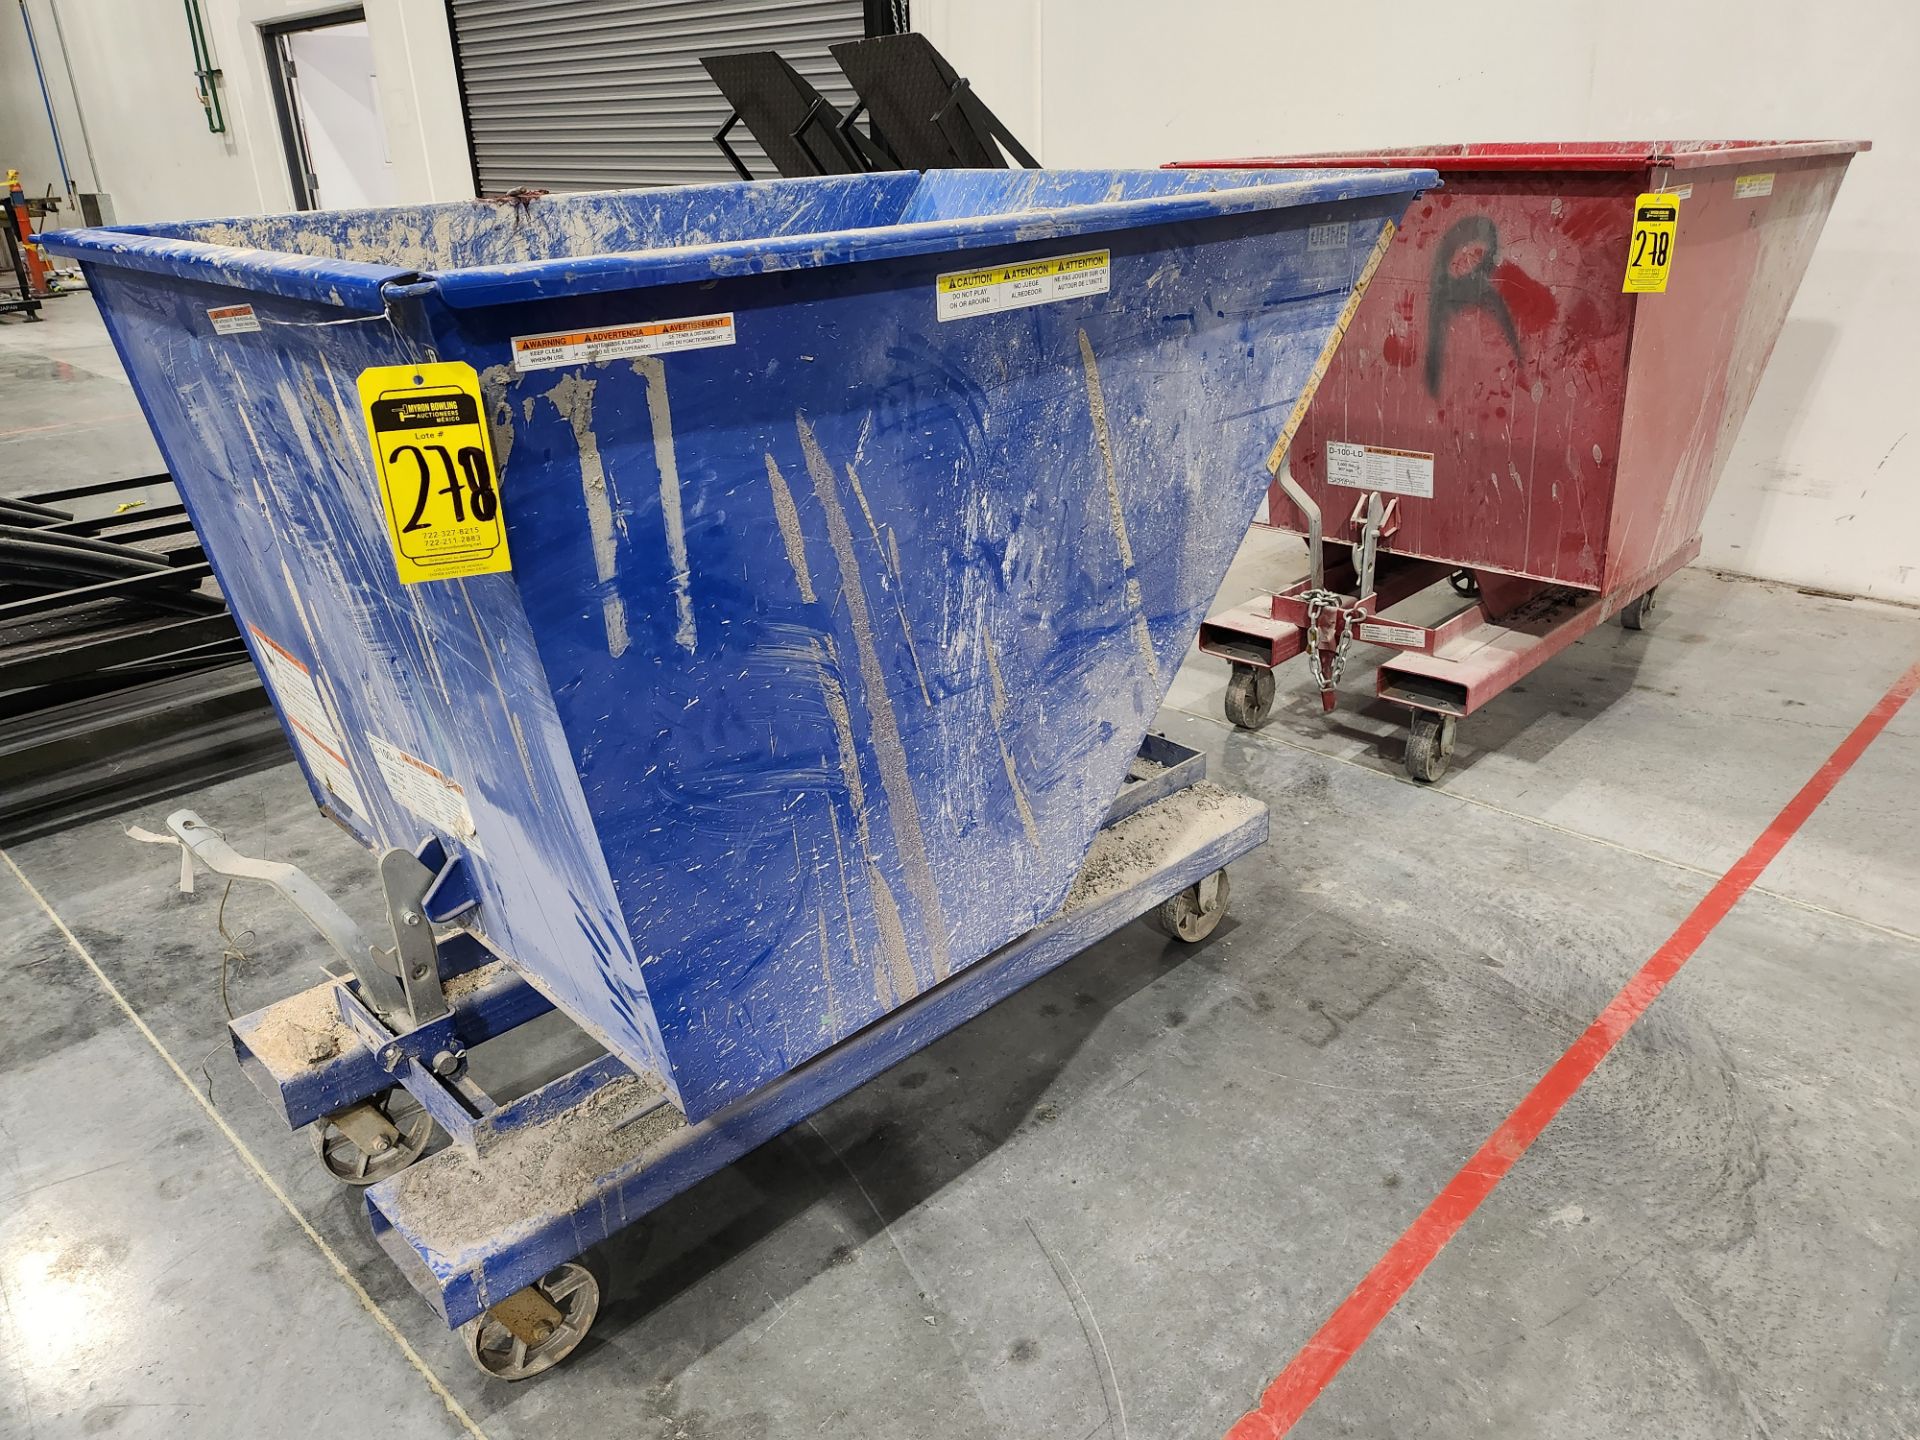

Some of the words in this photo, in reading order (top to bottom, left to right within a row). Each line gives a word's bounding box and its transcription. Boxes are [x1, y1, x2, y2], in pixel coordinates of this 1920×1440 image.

[1632, 230, 1669, 267] 278
[1065, 256, 1104, 270] ATTENTION
[956, 273, 993, 288] CAUTION
[961, 290, 973, 298] NOT
[973, 288, 988, 297] PLAY
[968, 297, 991, 306] AROUND
[1425, 215, 1523, 399] R
[670, 320, 723, 331] AVERTISSEMENT
[592, 329, 644, 341] ADVERTENCIA
[529, 337, 567, 350] WARNING
[408, 402, 430, 413] MYRON
[430, 400, 458, 411] BOWLING
[416, 409, 459, 419] AUCTIONEERS
[415, 432, 435, 440] Lote
[1329, 446, 1363, 458] D-100-LD
[389, 445, 497, 533] 278
[423, 527, 479, 539] 722-327-8215
